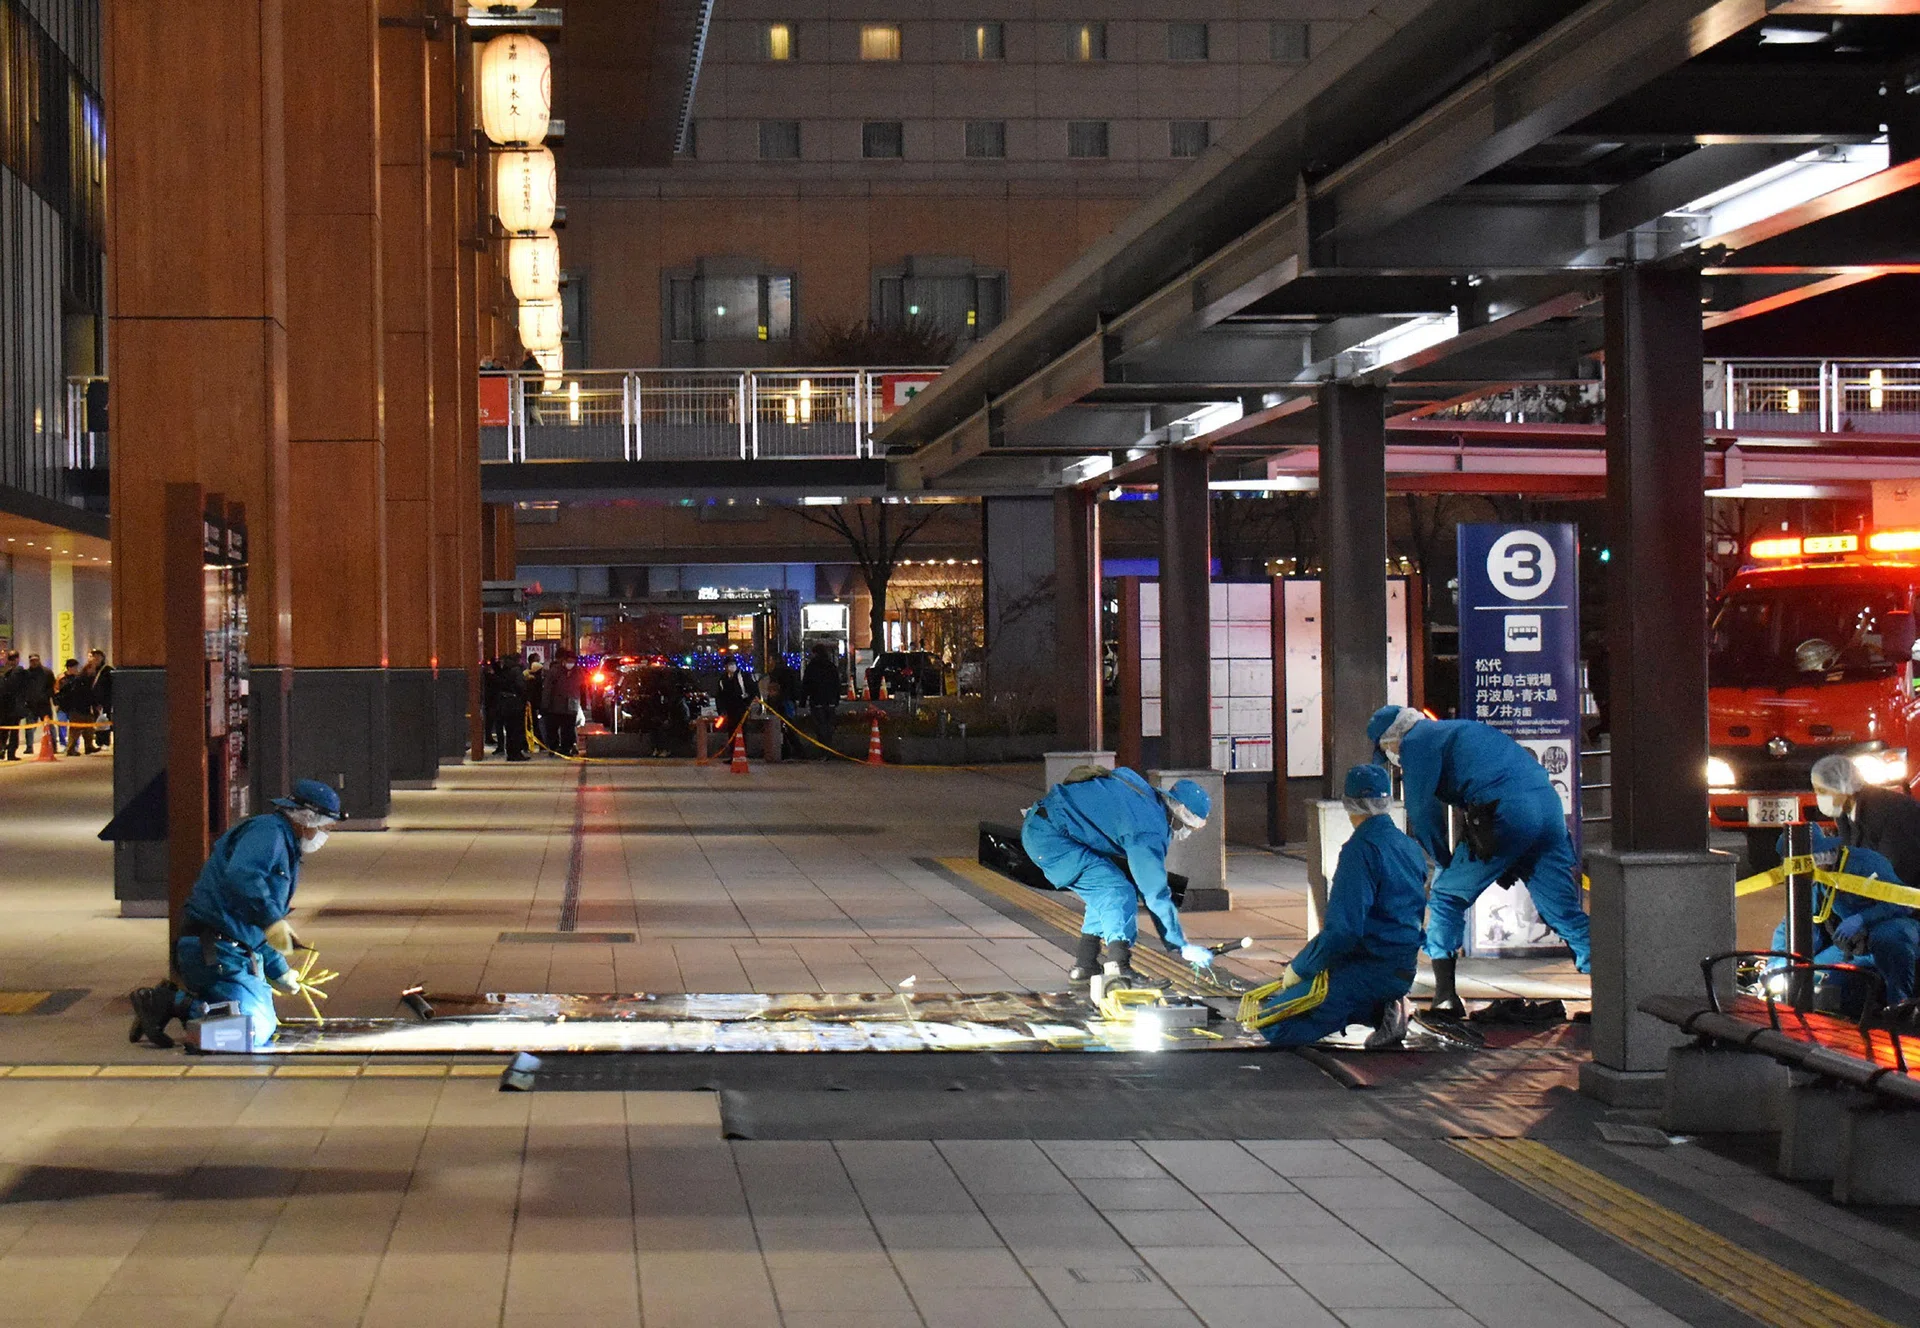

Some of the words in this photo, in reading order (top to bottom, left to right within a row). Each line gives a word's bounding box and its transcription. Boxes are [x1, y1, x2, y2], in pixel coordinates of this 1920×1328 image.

[1503, 543, 1542, 587] 3
[1475, 658, 1502, 672] 松代
[1475, 673, 1552, 688] 川中島古戦場
[1475, 689, 1558, 703] 丹波島・青木島
[1475, 704, 1532, 718] 篠ノ井方面
